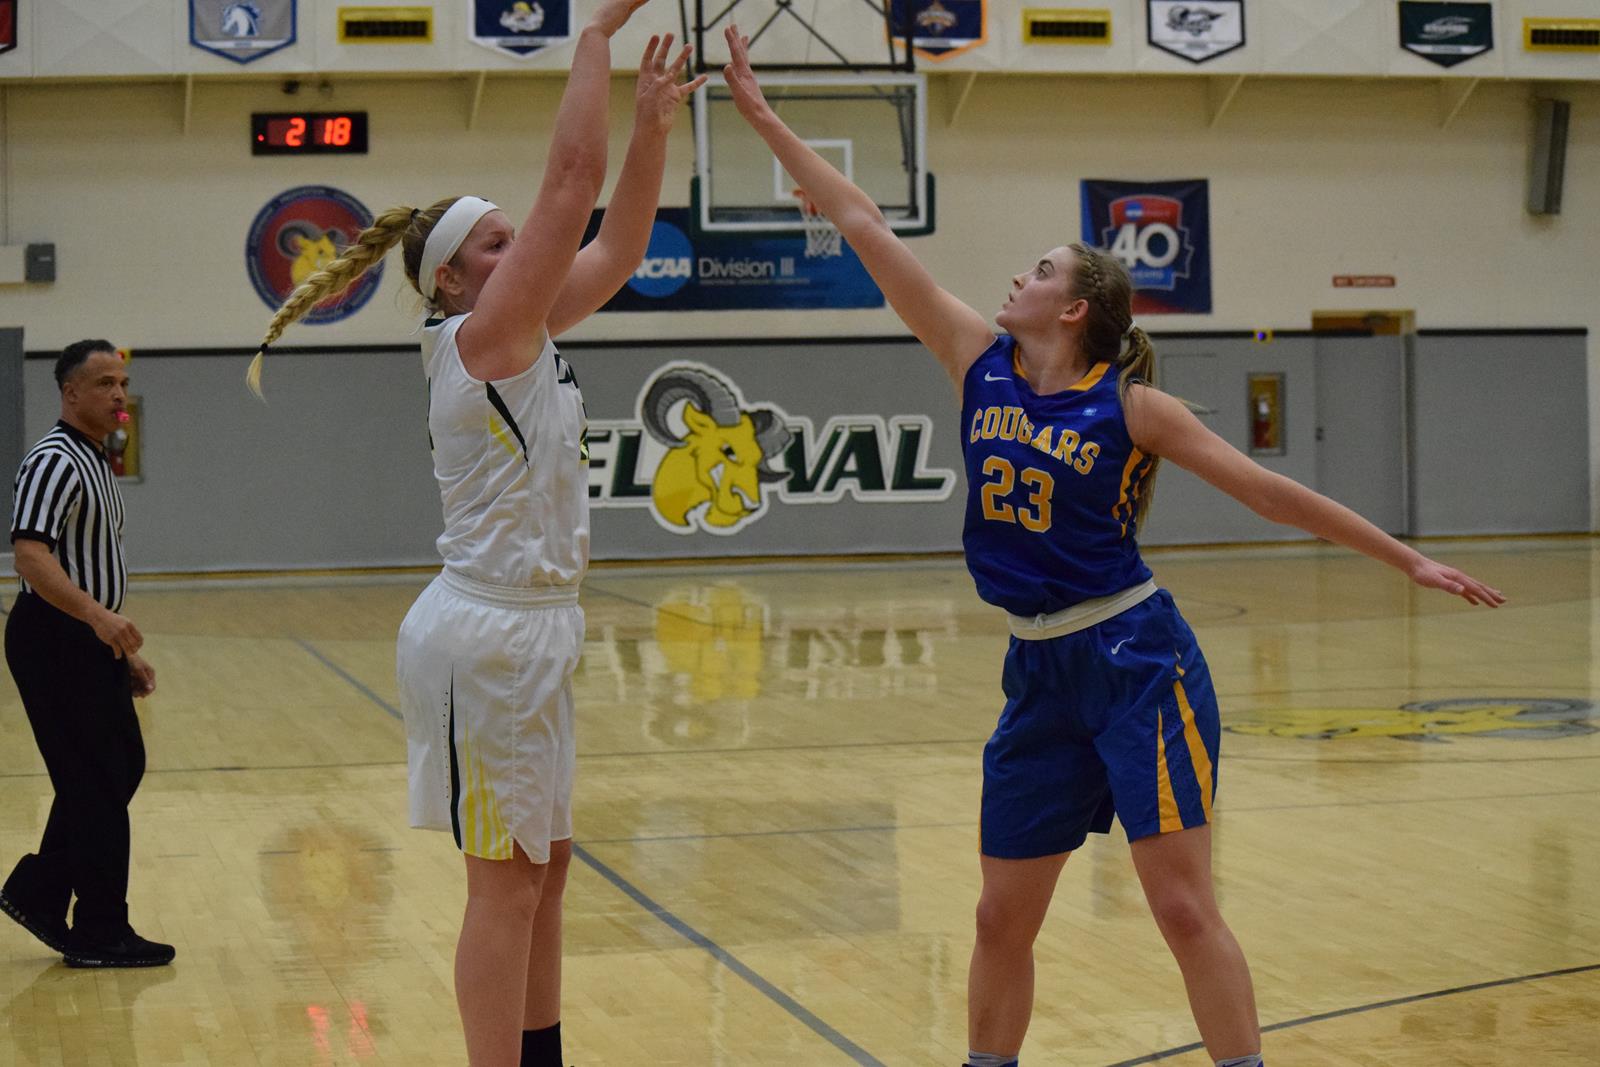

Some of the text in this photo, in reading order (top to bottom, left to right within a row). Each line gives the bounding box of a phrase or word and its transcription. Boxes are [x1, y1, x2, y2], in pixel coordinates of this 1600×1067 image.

[285, 117, 352, 147] 2 18
[698, 257, 776, 278] Division
[780, 257, 795, 277] III
[1111, 222, 1180, 268] 40
[785, 424, 948, 493] VAL
[969, 406, 1101, 476] COUGARS
[980, 455, 1055, 534] 23
